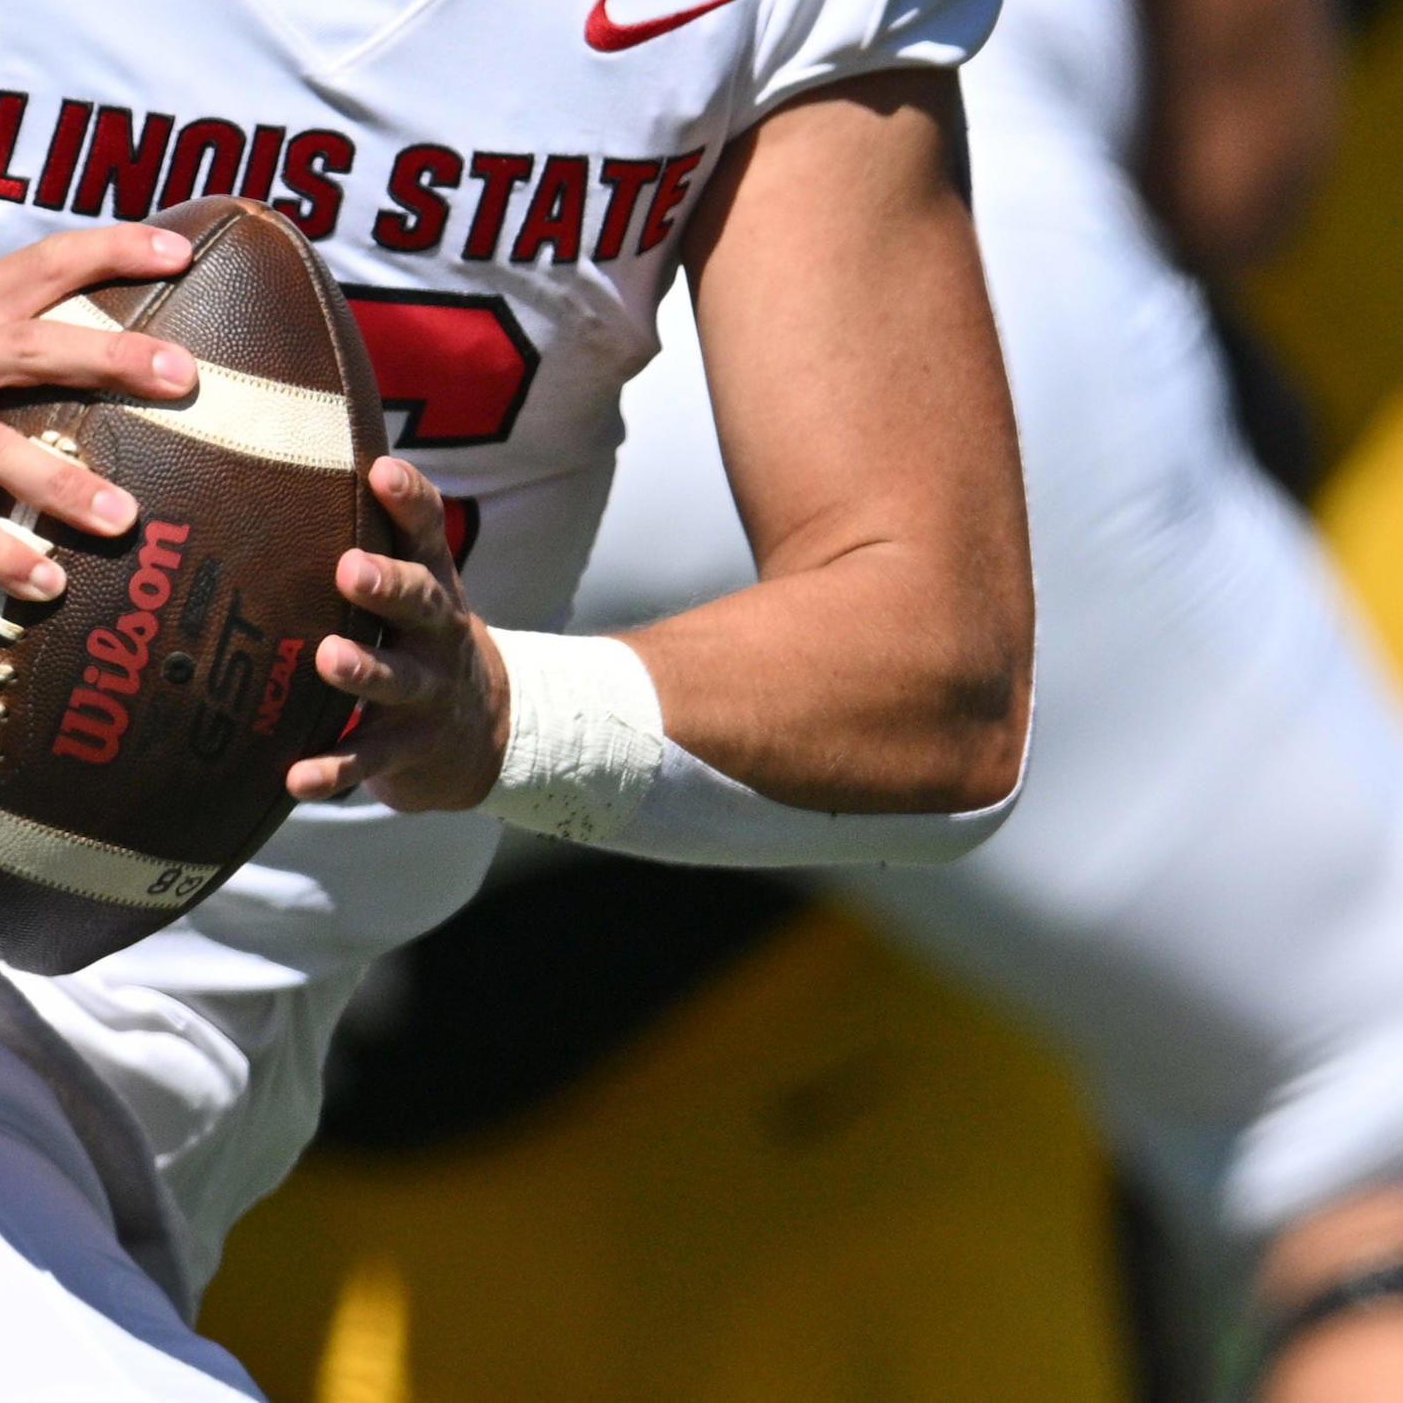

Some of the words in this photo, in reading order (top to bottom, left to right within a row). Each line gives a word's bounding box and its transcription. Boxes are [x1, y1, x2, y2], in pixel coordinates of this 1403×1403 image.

[372, 142, 706, 265] STATE
[52, 518, 191, 764] Wilson
[253, 638, 305, 736] NCAA
